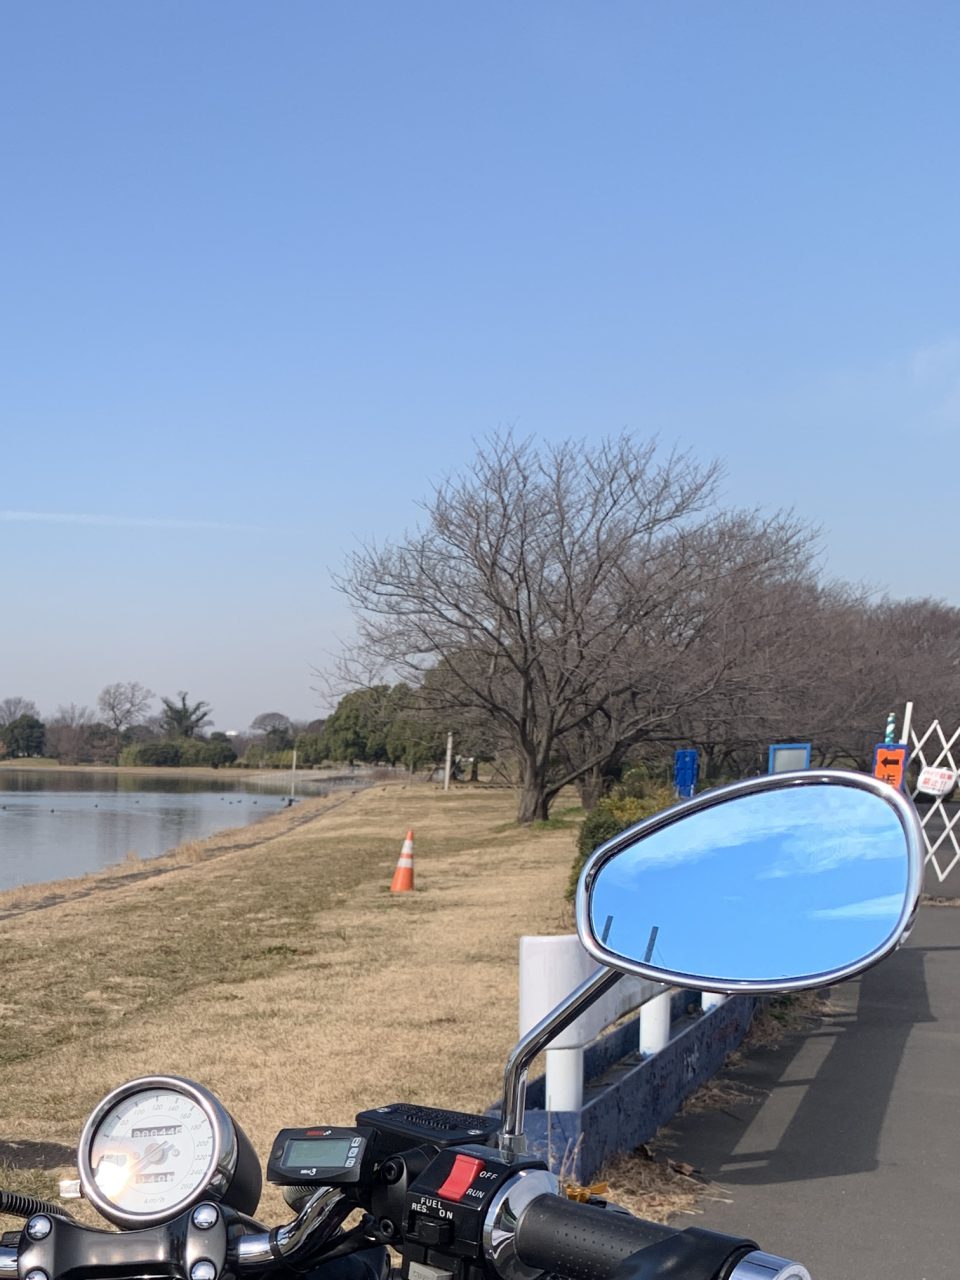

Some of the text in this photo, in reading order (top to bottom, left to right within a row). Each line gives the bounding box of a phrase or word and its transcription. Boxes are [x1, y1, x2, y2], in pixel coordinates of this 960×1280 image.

[479, 1170, 499, 1180] OFF
[465, 1188, 485, 1199] RUN
[411, 1202, 430, 1214] RES.
[420, 1197, 442, 1209] FUEL
[439, 1209, 453, 1219] ON
